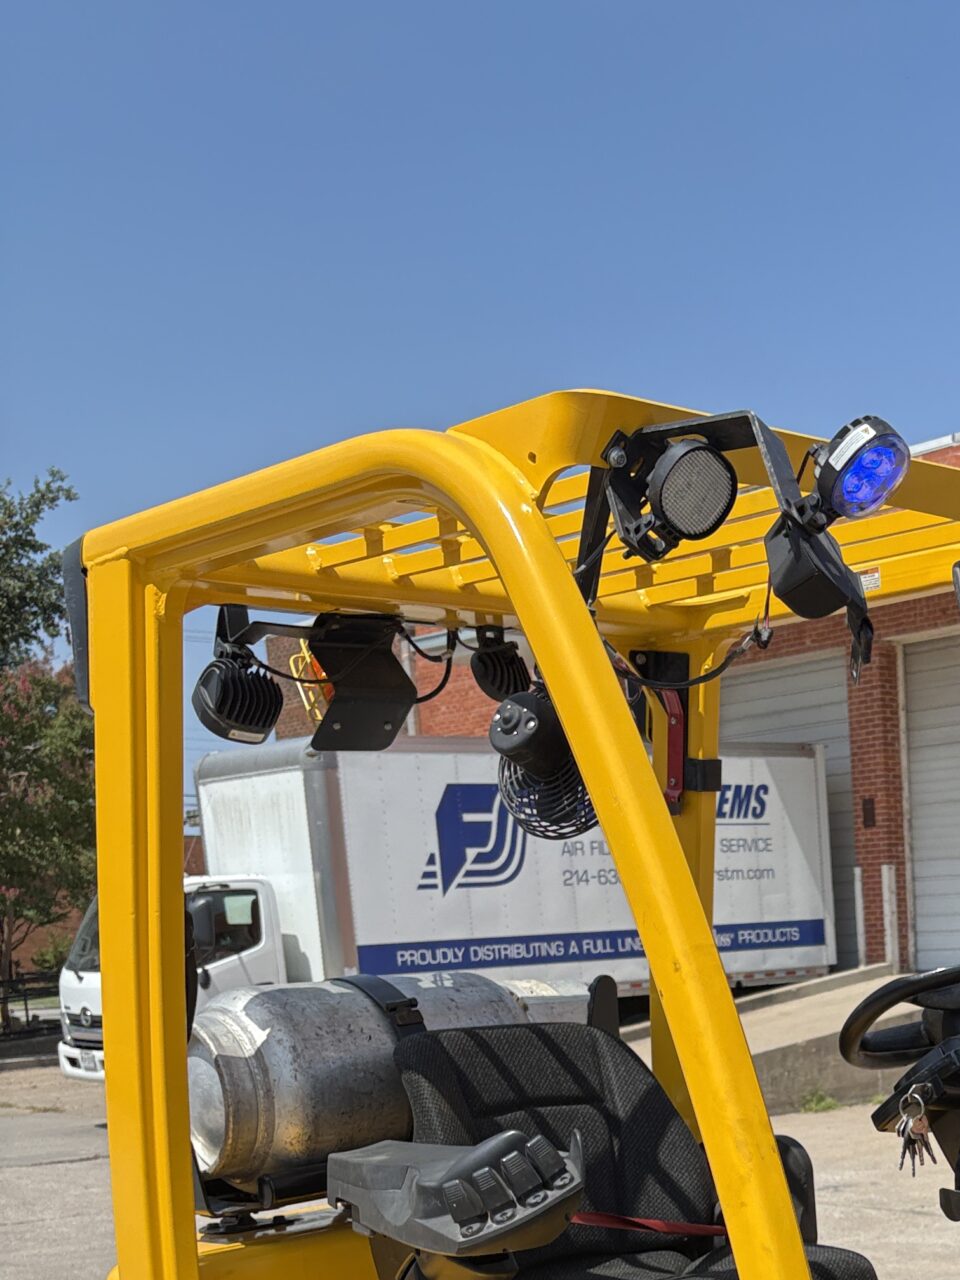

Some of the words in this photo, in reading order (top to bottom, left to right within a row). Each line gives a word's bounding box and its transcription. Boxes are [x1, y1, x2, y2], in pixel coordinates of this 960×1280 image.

[714, 783, 770, 820] EMS
[561, 840, 585, 857] AIR
[589, 839, 612, 857] FIL
[719, 837, 773, 854] SERVICE
[561, 868, 623, 887] 214-63
[714, 866, 776, 882] stm.com
[396, 946, 466, 967] PROUDLY
[469, 940, 565, 962] DISTRIBUTING
[568, 940, 580, 955] A
[582, 938, 615, 955] FULL
[737, 926, 801, 945] PRODUCTS
